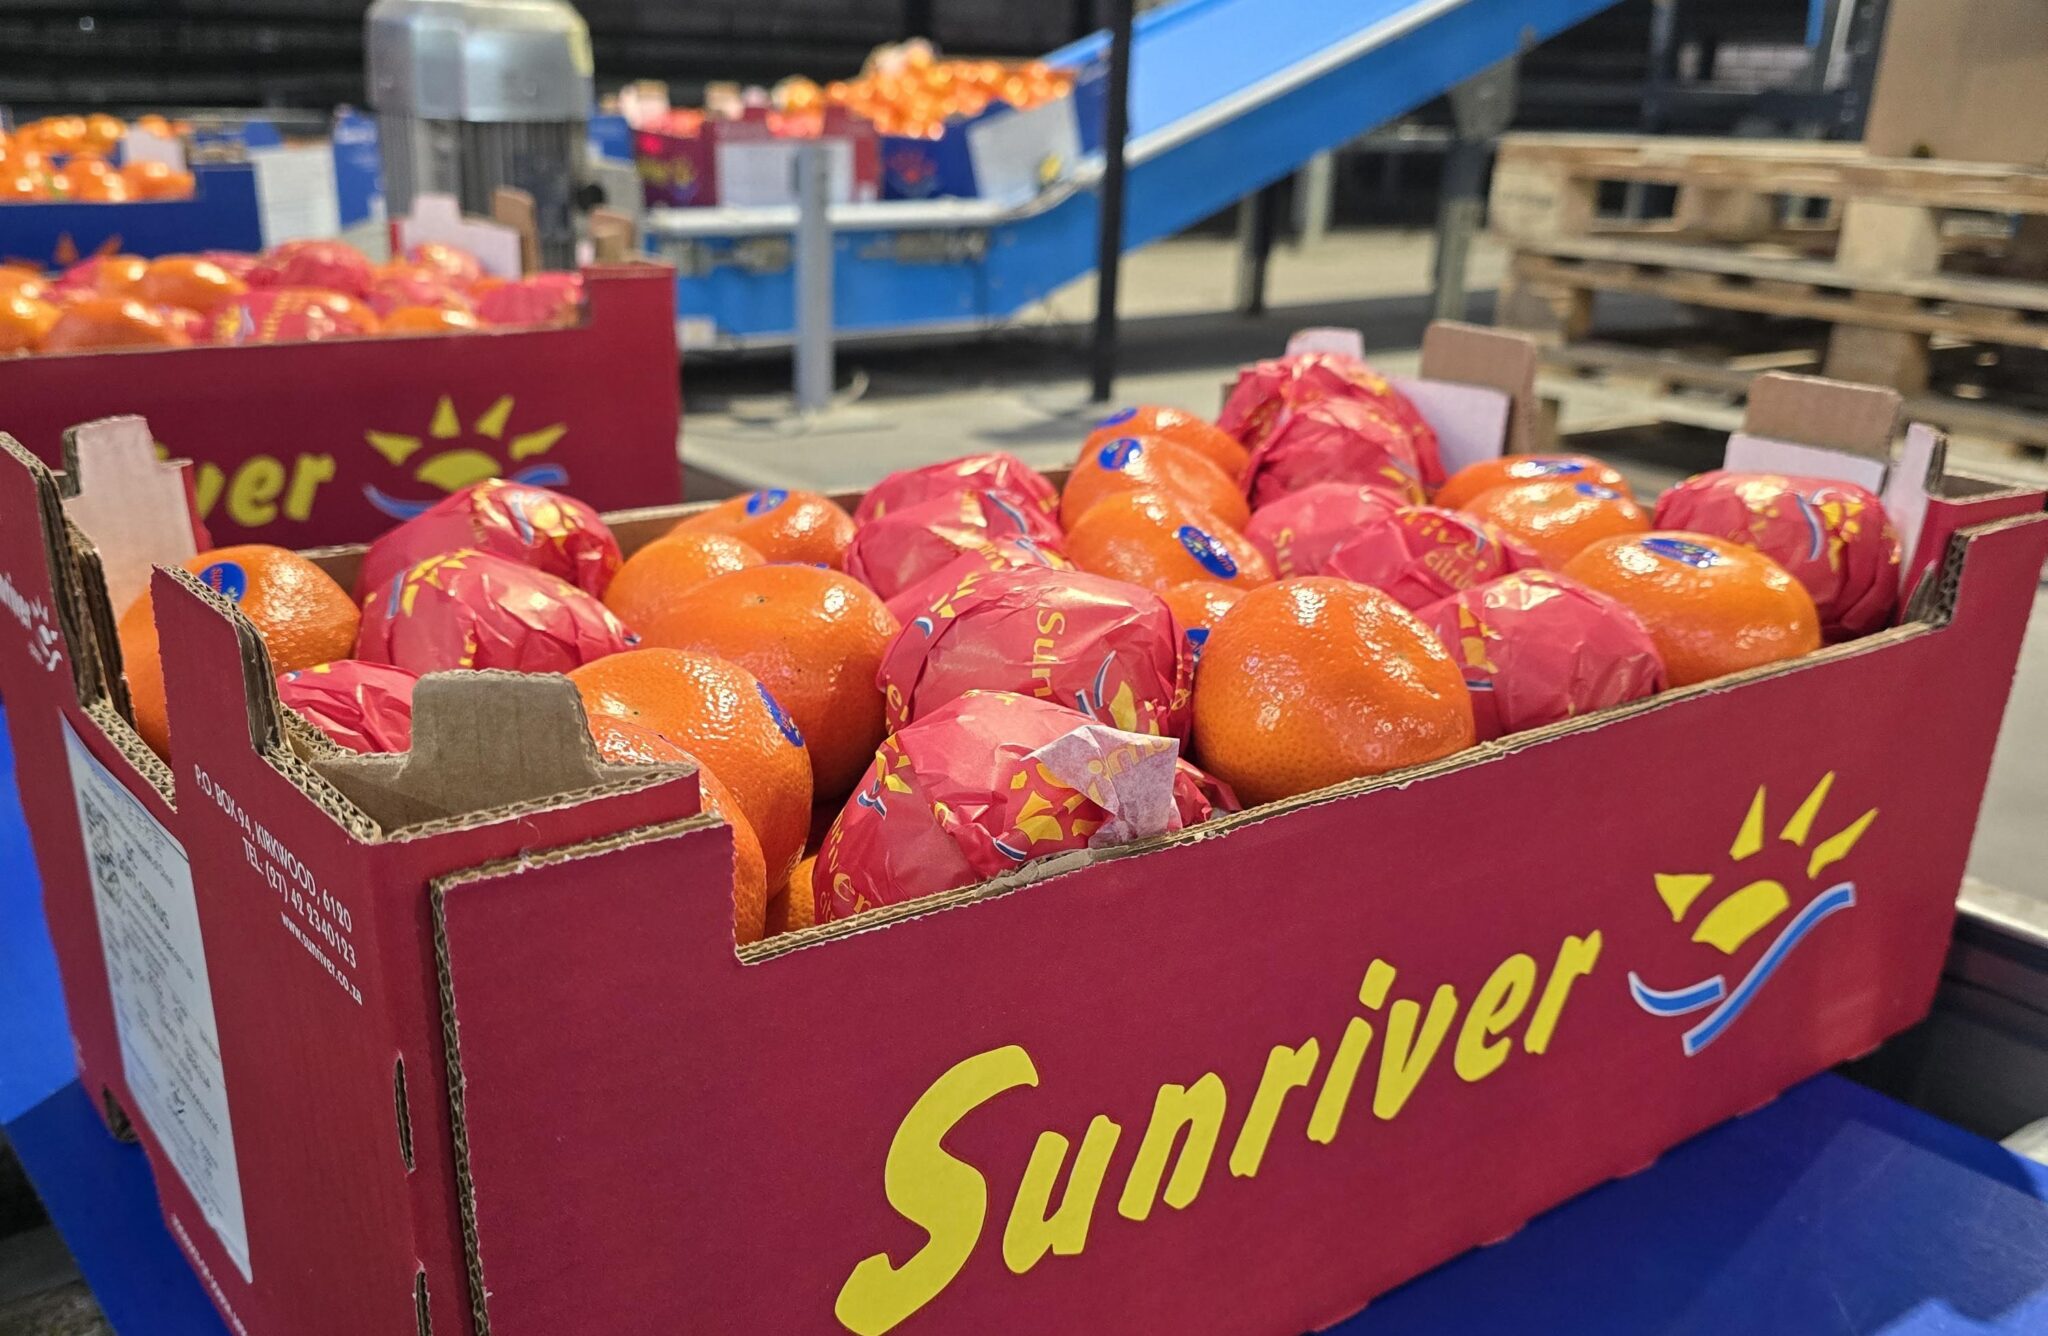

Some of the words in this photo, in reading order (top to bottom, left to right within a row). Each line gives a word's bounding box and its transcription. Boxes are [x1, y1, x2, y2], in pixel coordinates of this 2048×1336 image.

[156, 441, 337, 527] ver
[194, 763, 215, 800] P.O.
[214, 782, 238, 823] BOX
[237, 807, 255, 841] 94,
[323, 888, 352, 934] 6120
[265, 860, 288, 903] (27)
[291, 887, 304, 917] 42
[306, 902, 357, 969] 2340123
[281, 911, 363, 1007] www.sunriver.co.za
[834, 930, 1603, 1336] Sunriver
